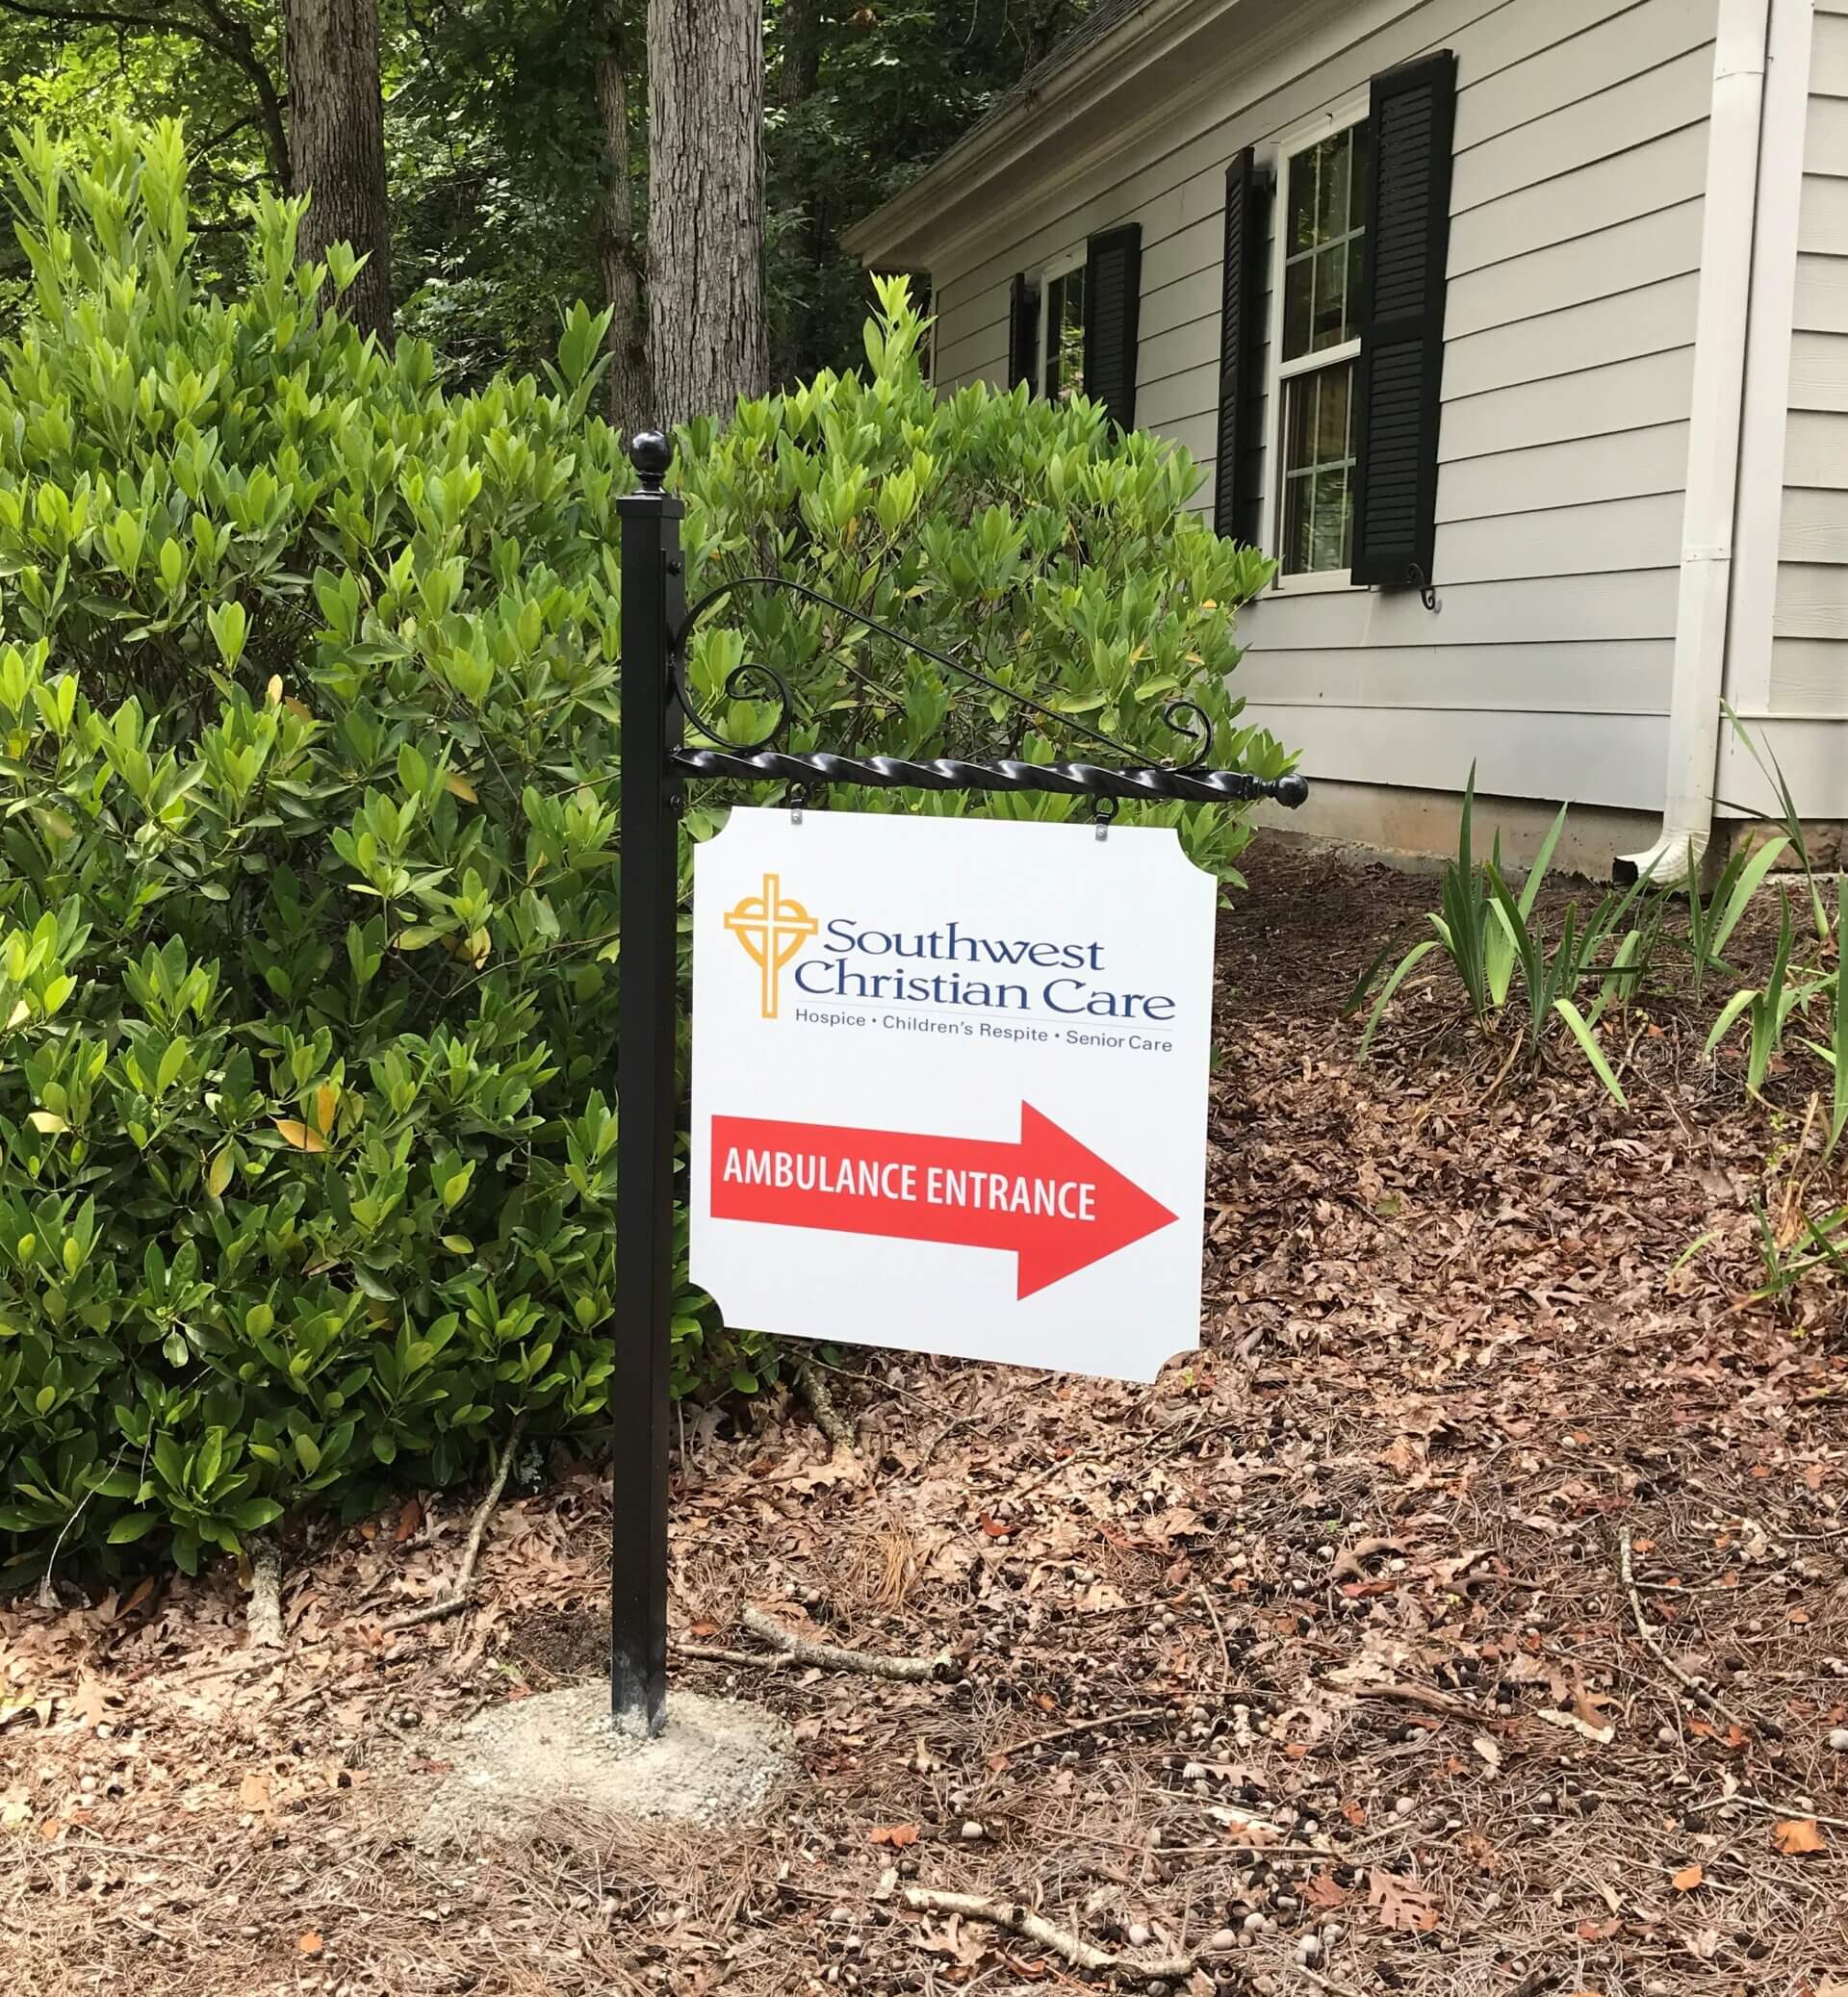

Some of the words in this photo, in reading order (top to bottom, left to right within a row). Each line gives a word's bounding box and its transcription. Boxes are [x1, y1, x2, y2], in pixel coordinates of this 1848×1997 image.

[823, 918, 1105, 971] Southwest
[794, 959, 1031, 1011] Christian
[1042, 978, 1176, 1021] Care
[795, 1008, 866, 1028] Hospice
[883, 1015, 973, 1037] Children's
[980, 1023, 1049, 1043] Respite
[1065, 1030, 1124, 1049] Senior
[1128, 1035, 1173, 1053] Care
[723, 1146, 917, 1201] AMBULANCE
[927, 1166, 1096, 1221] ENTRANCE
